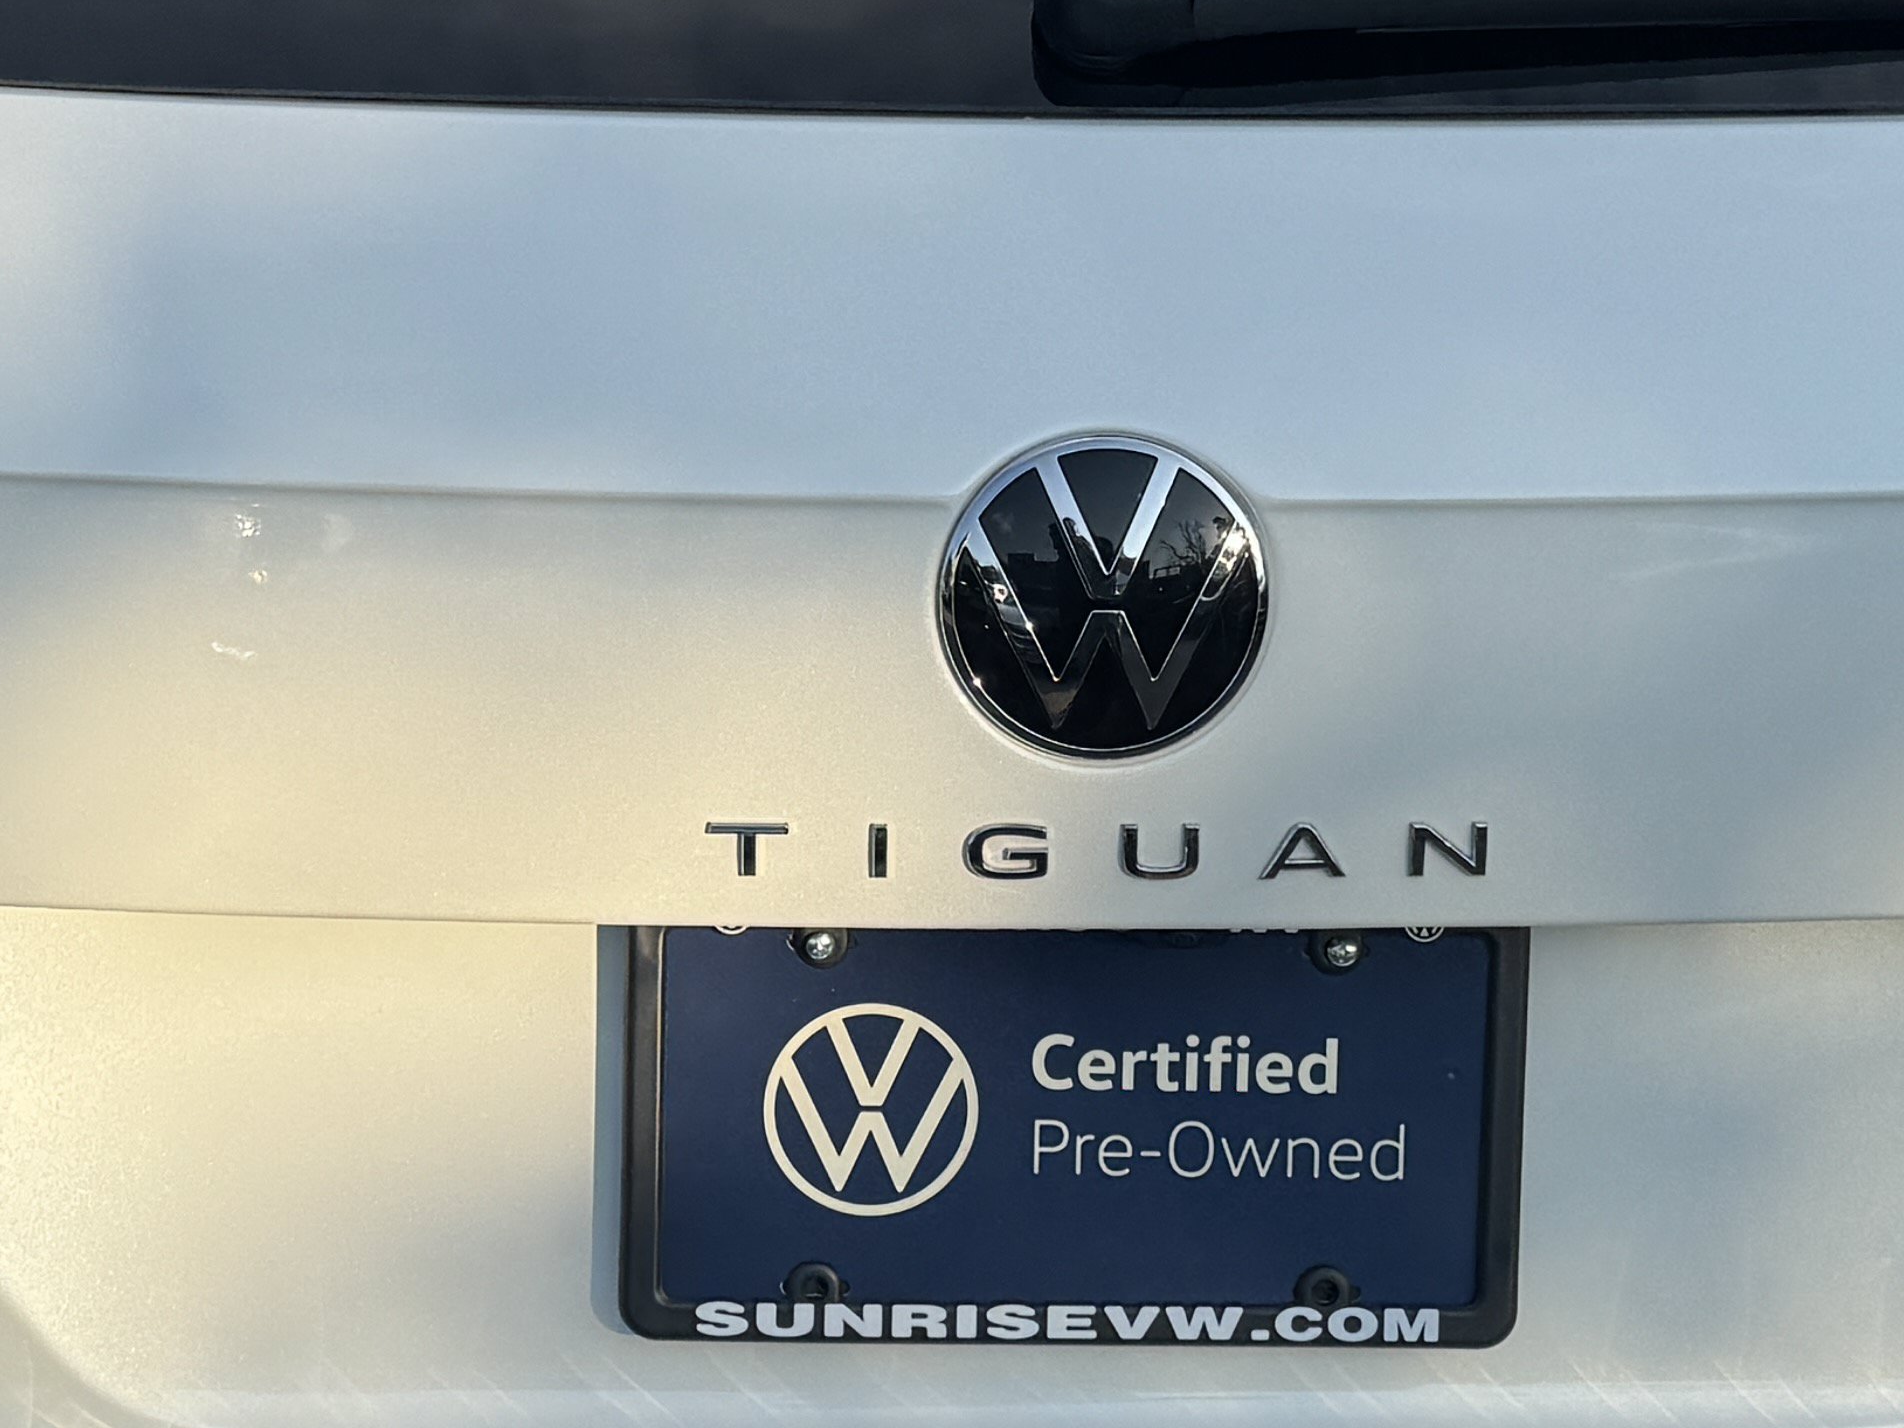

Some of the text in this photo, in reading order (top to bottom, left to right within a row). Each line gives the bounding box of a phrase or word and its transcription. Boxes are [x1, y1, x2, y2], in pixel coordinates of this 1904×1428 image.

[962, 442, 1253, 740] VW
[703, 821, 1490, 881] TIGUAN
[1033, 1033, 1339, 1095] Certified
[776, 1013, 968, 1196] VW
[1033, 1118, 1406, 1181] Pre-Owned
[695, 1299, 1440, 1345] SUNRISEVW.COM
